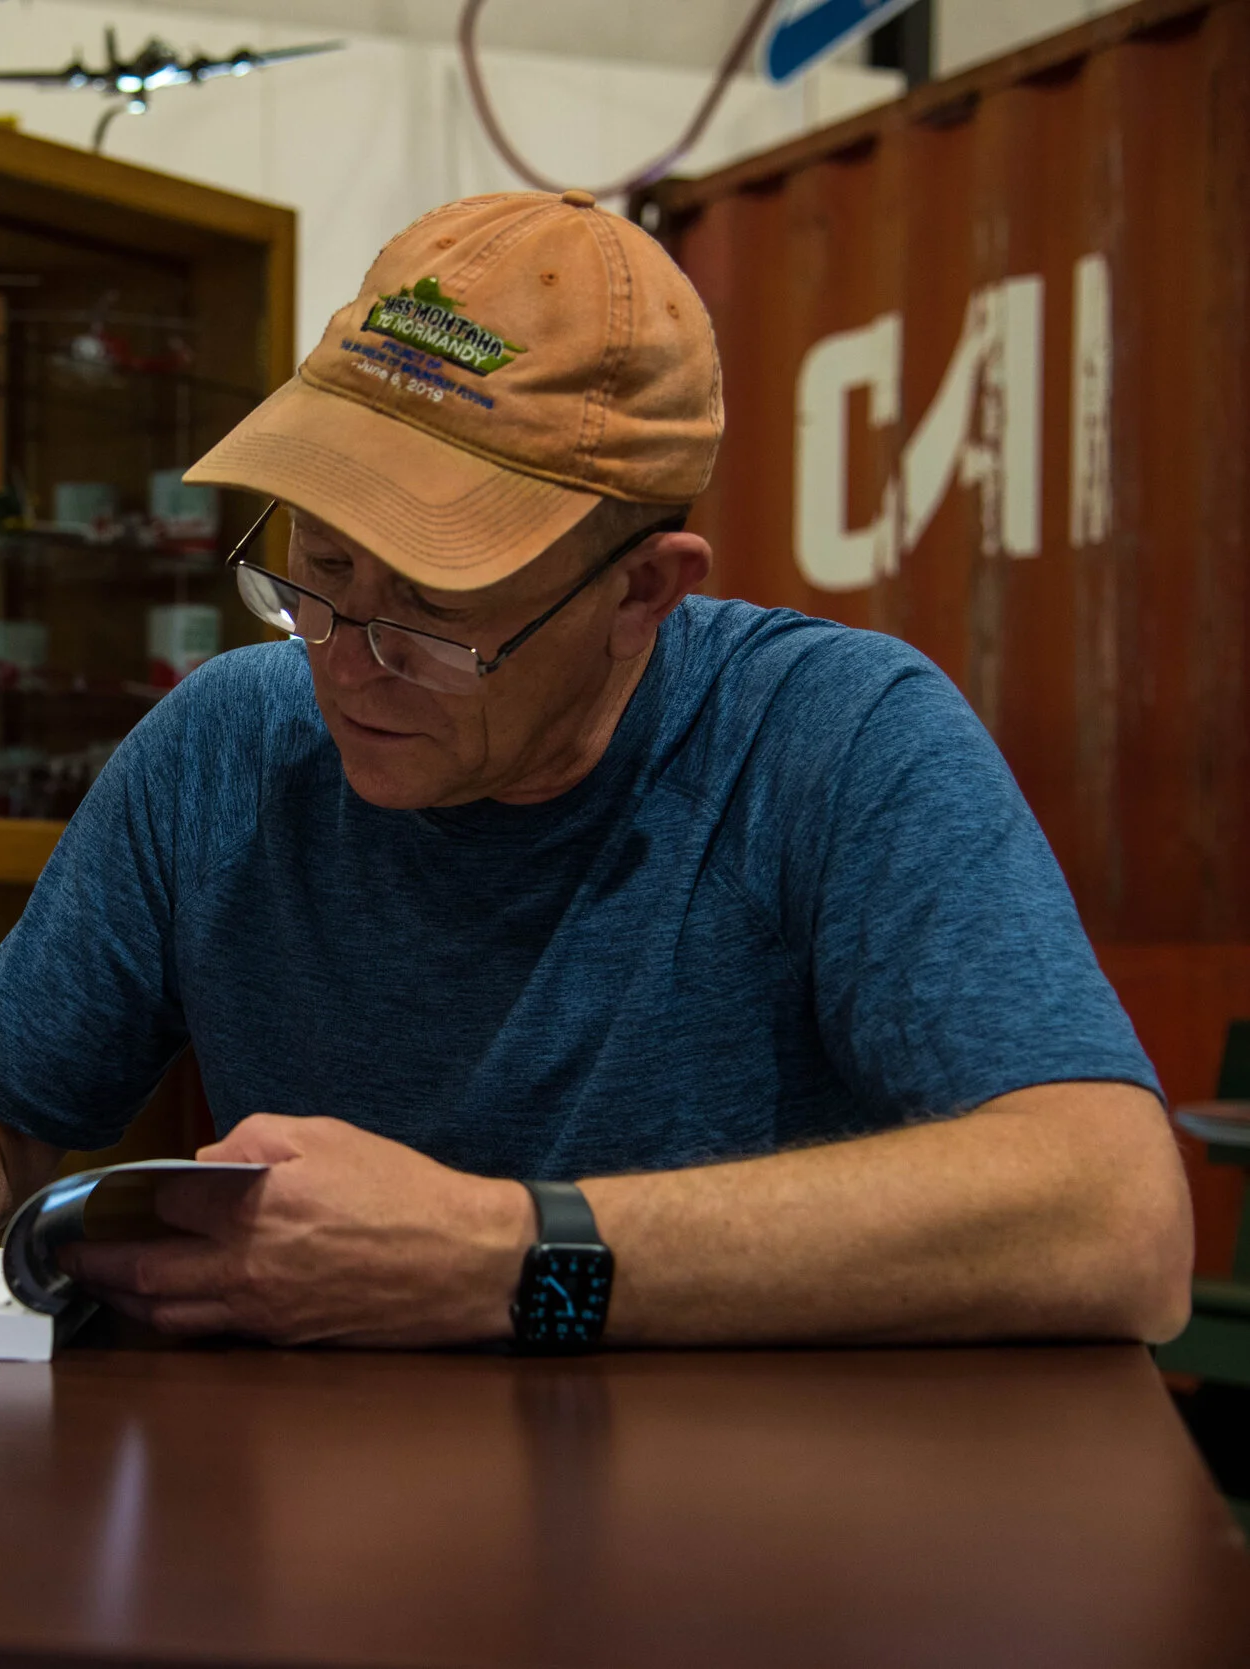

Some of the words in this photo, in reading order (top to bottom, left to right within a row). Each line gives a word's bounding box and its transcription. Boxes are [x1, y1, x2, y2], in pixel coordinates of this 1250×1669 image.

[377, 313, 392, 327] TO
[394, 317, 487, 366] NORMANDY
[383, 297, 414, 317] MISS
[414, 302, 504, 359] MONTANA
[406, 379, 444, 403] 2019
[796, 253, 1112, 590] CAI
